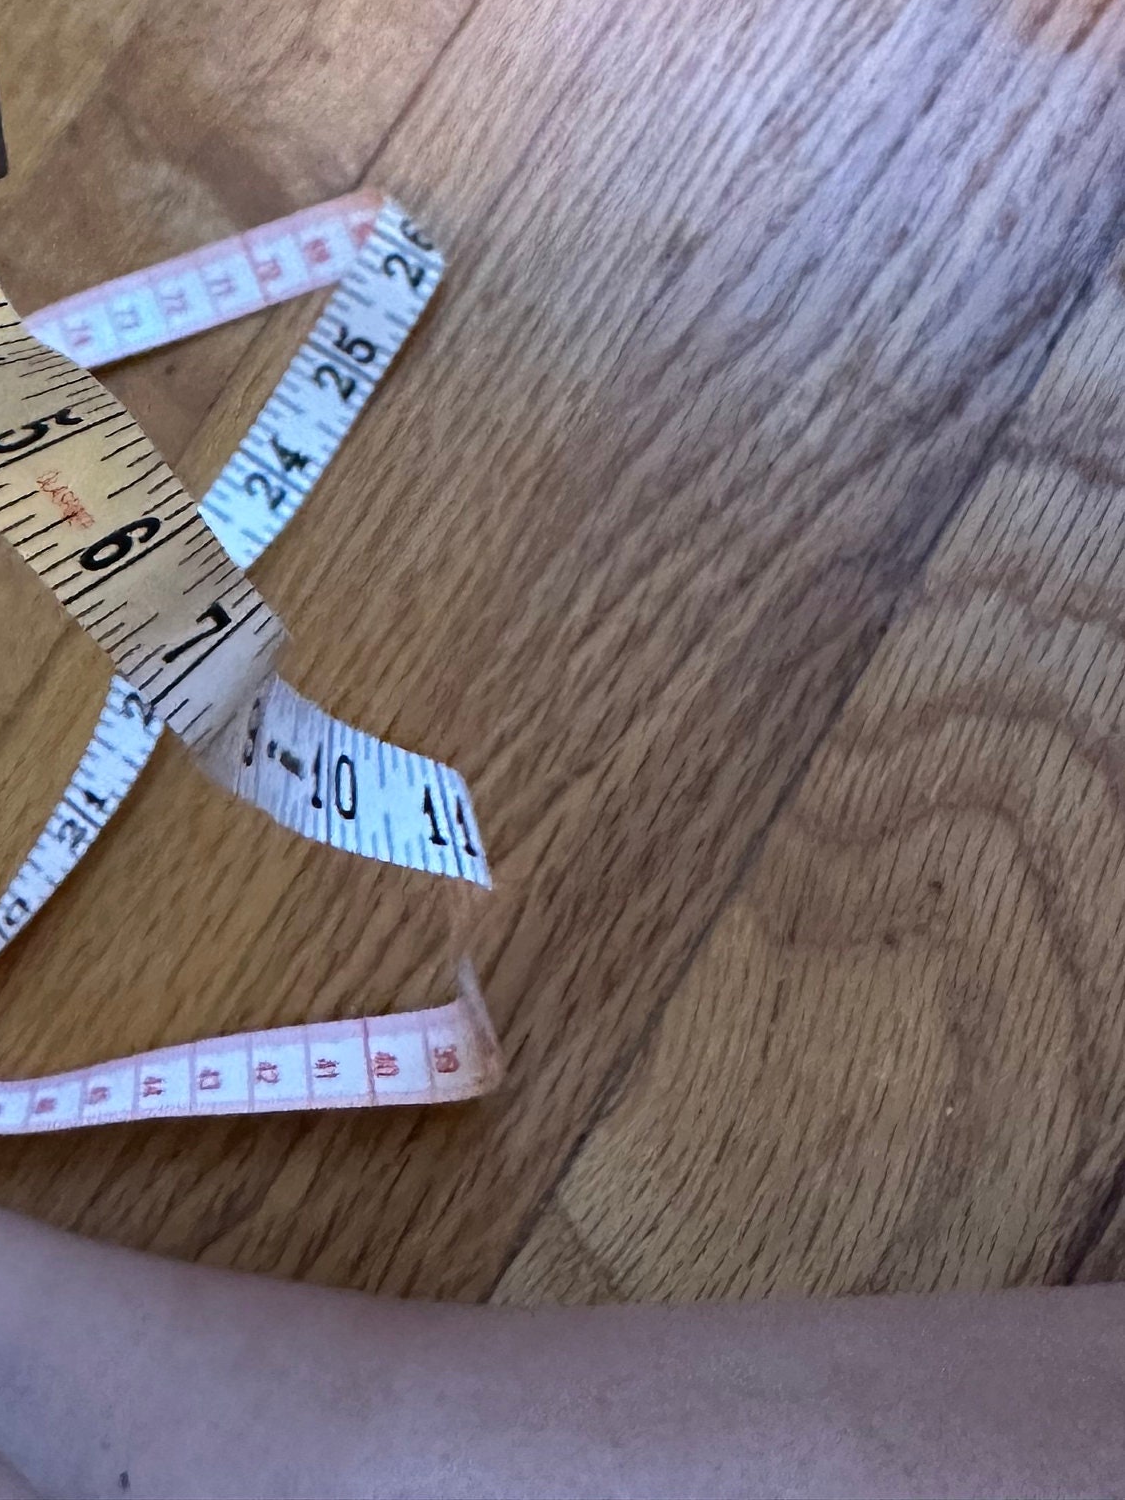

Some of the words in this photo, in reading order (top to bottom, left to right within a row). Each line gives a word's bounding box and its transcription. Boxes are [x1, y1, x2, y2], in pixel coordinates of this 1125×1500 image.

[244, 435, 312, 511] 24
[79, 516, 162, 572] 6
[161, 601, 232, 665] 7
[310, 742, 357, 820] 10
[421, 784, 478, 858] 11
